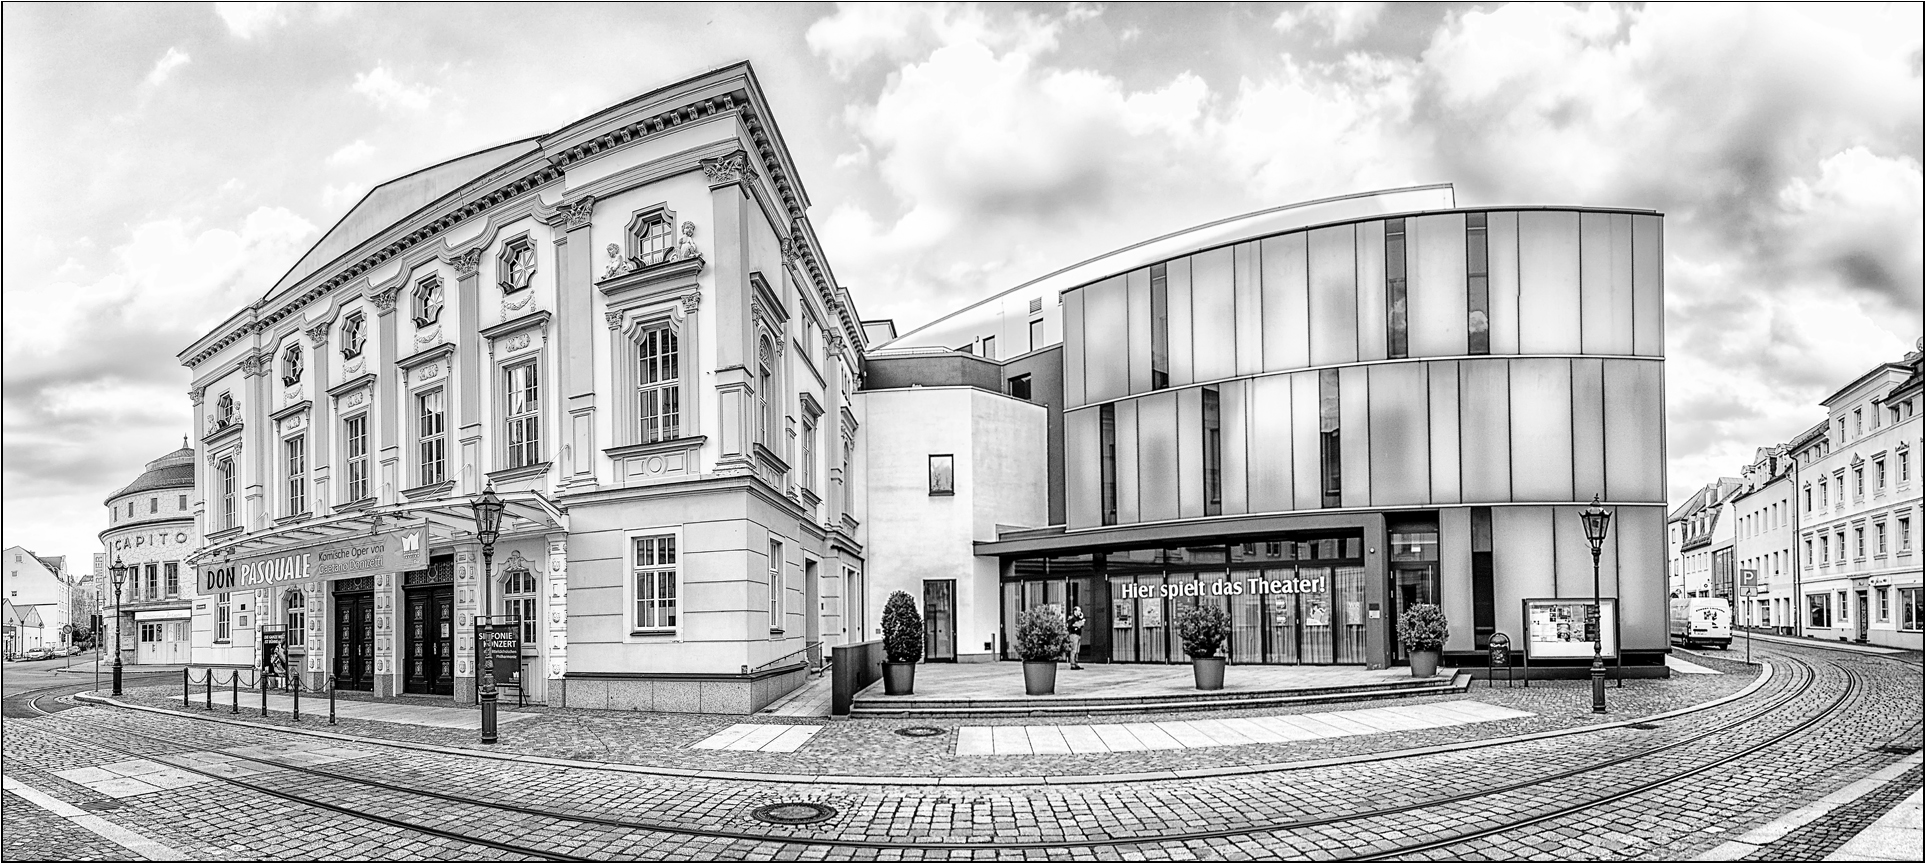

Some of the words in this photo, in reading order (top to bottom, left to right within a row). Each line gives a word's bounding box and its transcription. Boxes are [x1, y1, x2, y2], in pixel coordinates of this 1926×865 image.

[318, 548, 350, 561] Komische
[351, 547, 369, 558] Oper
[370, 544, 385, 554] von
[207, 566, 235, 590] DON
[241, 553, 311, 586] PASQUALE
[319, 562, 348, 574] Gaetano
[349, 555, 384, 570] Donizetti
[95, 556, 103, 597] BARMER
[1743, 571, 1754, 585] P
[1121, 583, 1155, 599] Hier
[1160, 580, 1206, 600] spielt
[1212, 579, 1243, 596] das
[1247, 576, 1326, 595] Theater!
[478, 632, 513, 640] SIFONIE
